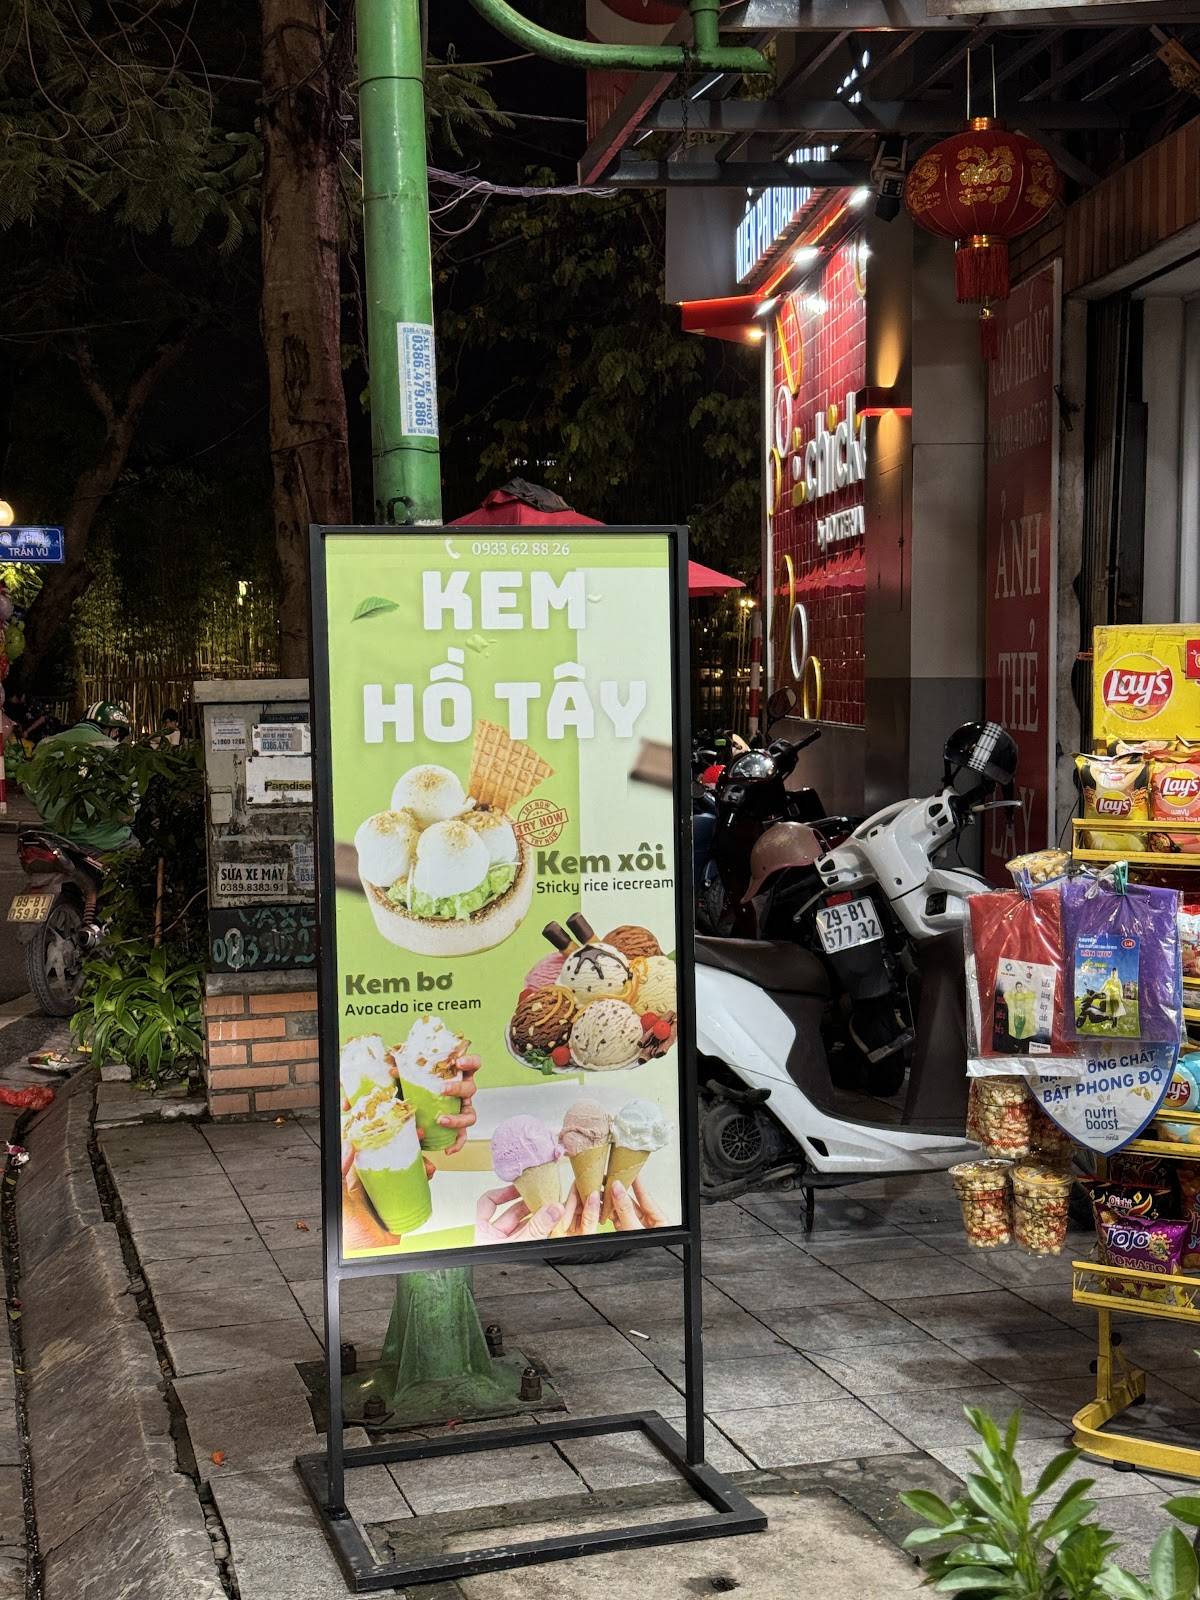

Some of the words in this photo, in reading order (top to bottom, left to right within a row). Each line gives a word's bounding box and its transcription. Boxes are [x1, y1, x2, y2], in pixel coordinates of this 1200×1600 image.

[411, 335, 427, 426] 0386.479.886
[471, 542, 507, 556] 0933
[511, 542, 528, 556] 62
[532, 542, 549, 556] 88
[552, 542, 570, 556] 26
[422, 570, 587, 631] KEM
[363, 646, 473, 744] HỒ
[494, 661, 648, 741] TÂY
[1107, 668, 1170, 707] Lay's
[264, 780, 312, 792] Paradise
[522, 804, 534, 816] TRY
[534, 801, 551, 809] NOW
[515, 820, 536, 837] TRY
[539, 811, 563, 828] NOW
[531, 837, 542, 845] TRY
[544, 830, 558, 844] NOW
[536, 850, 611, 875] Kem
[617, 842, 667, 872] xôi
[220, 863, 243, 881] SỬA
[245, 868, 259, 881] XE
[261, 865, 285, 881] MÁY
[536, 879, 580, 896] Sticky
[584, 878, 609, 892] rice
[613, 877, 674, 891] icecream
[822, 901, 867, 929] 29-B1
[824, 919, 880, 949] 577.32
[345, 974, 411, 996] Kem
[416, 971, 453, 992] bơ
[345, 1001, 409, 1016] Avocado
[413, 1000, 433, 1012] ice
[437, 999, 482, 1011] cream
[1120, 1049, 1156, 1068] CHẤT
[1043, 1084, 1072, 1104] BẬT
[1075, 1073, 1134, 1097] PHONG
[1138, 1065, 1163, 1086] ĐỘ
[1084, 1106, 1117, 1119] nutri
[1085, 1118, 1120, 1131] boost
